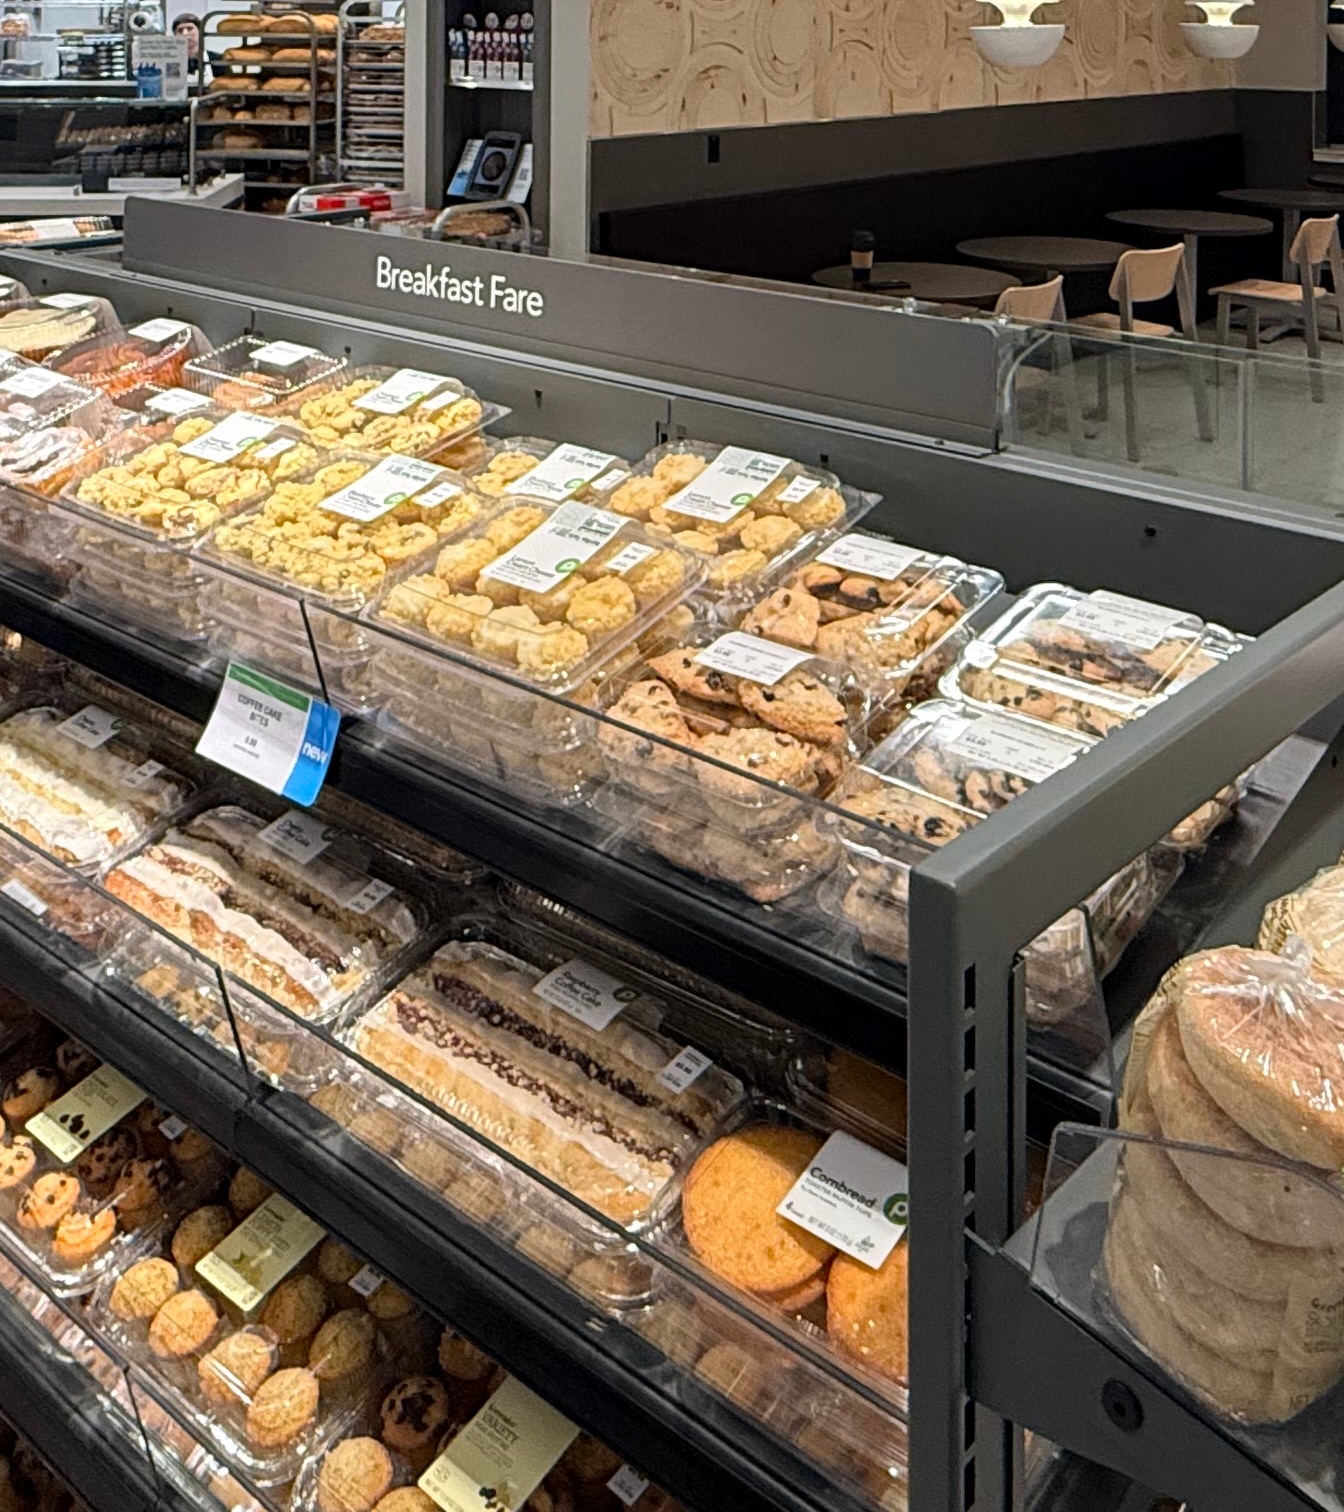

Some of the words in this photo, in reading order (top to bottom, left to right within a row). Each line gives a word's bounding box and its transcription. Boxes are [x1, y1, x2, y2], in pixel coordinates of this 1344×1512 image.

[375, 254, 485, 307] Breakfast
[489, 274, 545, 318] Fare
[237, 692, 265, 713] COFFEE
[264, 704, 283, 722] CAKE
[249, 712, 269, 728] BITES
[303, 740, 328, 765] new
[581, 992, 603, 1007] Cake
[809, 1166, 878, 1210] Cornbread
